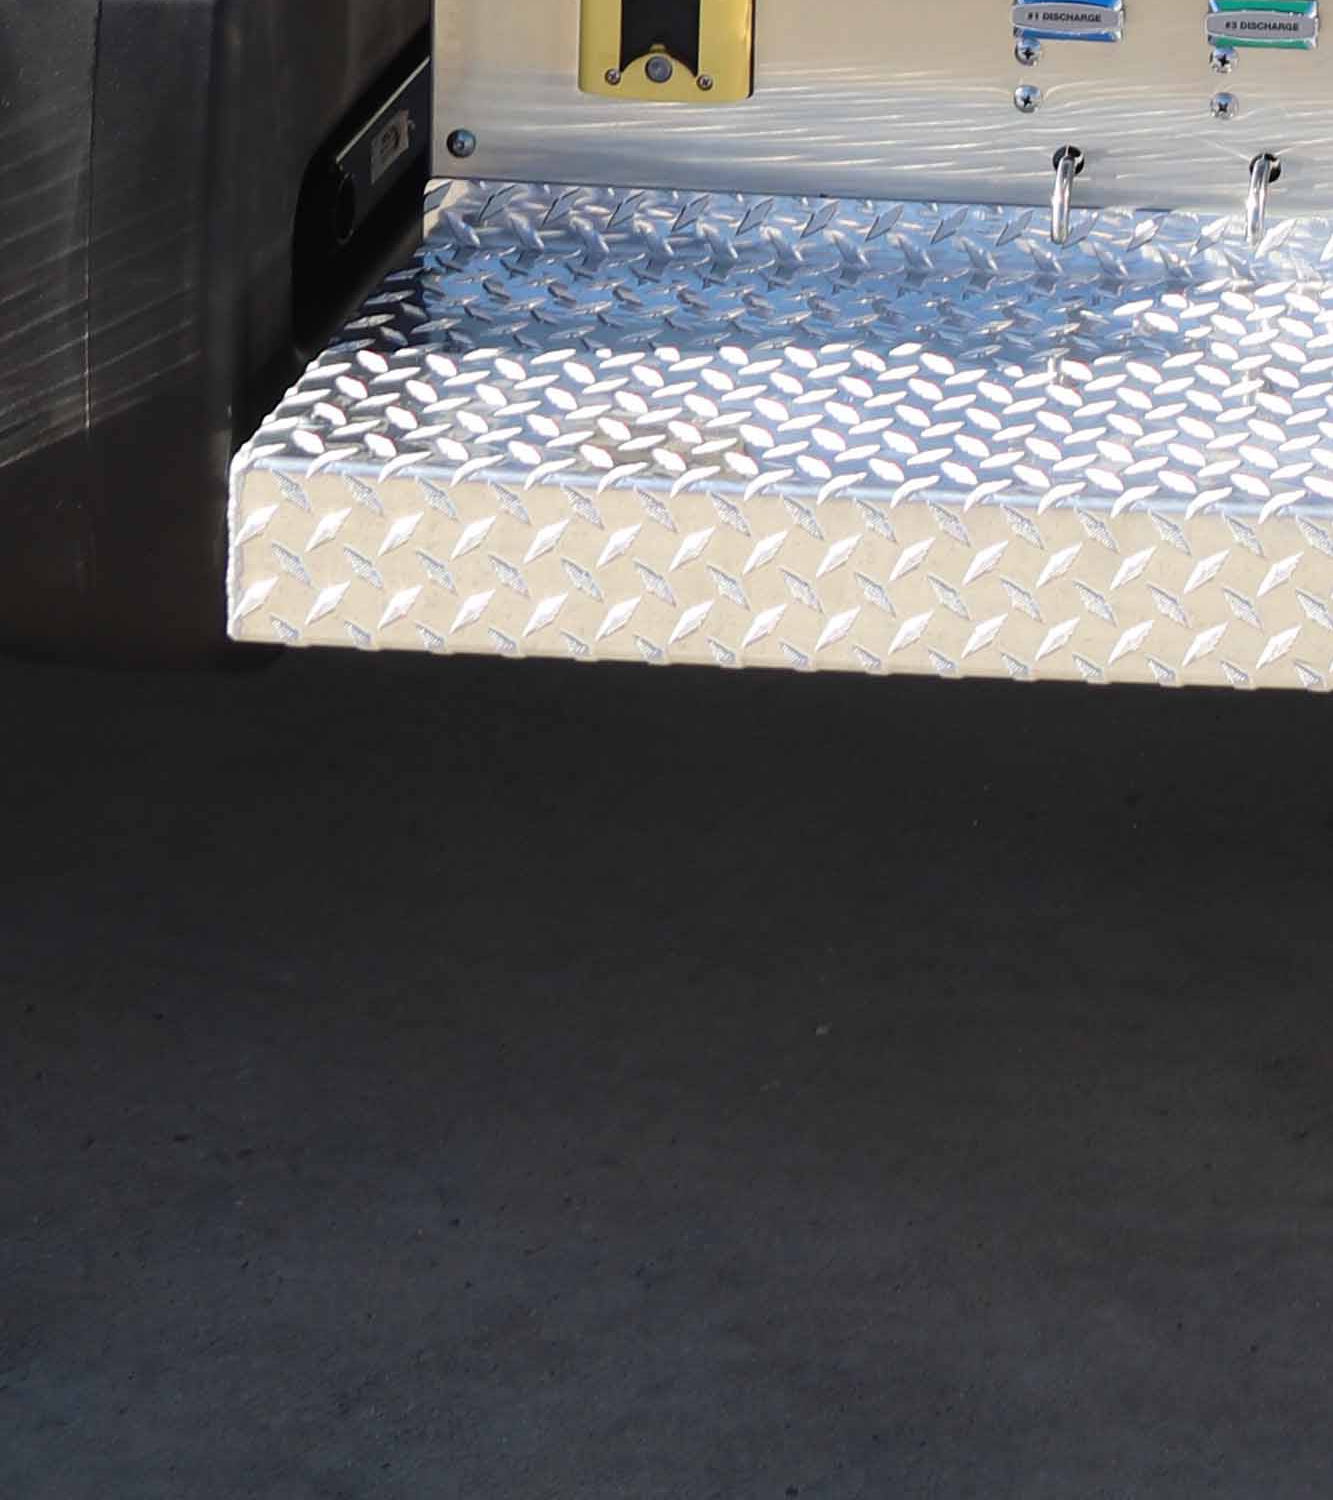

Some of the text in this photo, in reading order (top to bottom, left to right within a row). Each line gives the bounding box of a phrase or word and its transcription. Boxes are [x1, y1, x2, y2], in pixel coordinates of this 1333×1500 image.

[1028, 12, 1101, 24] #1 DISCHARGE
[1225, 21, 1299, 32] #3 DISCHARGE
